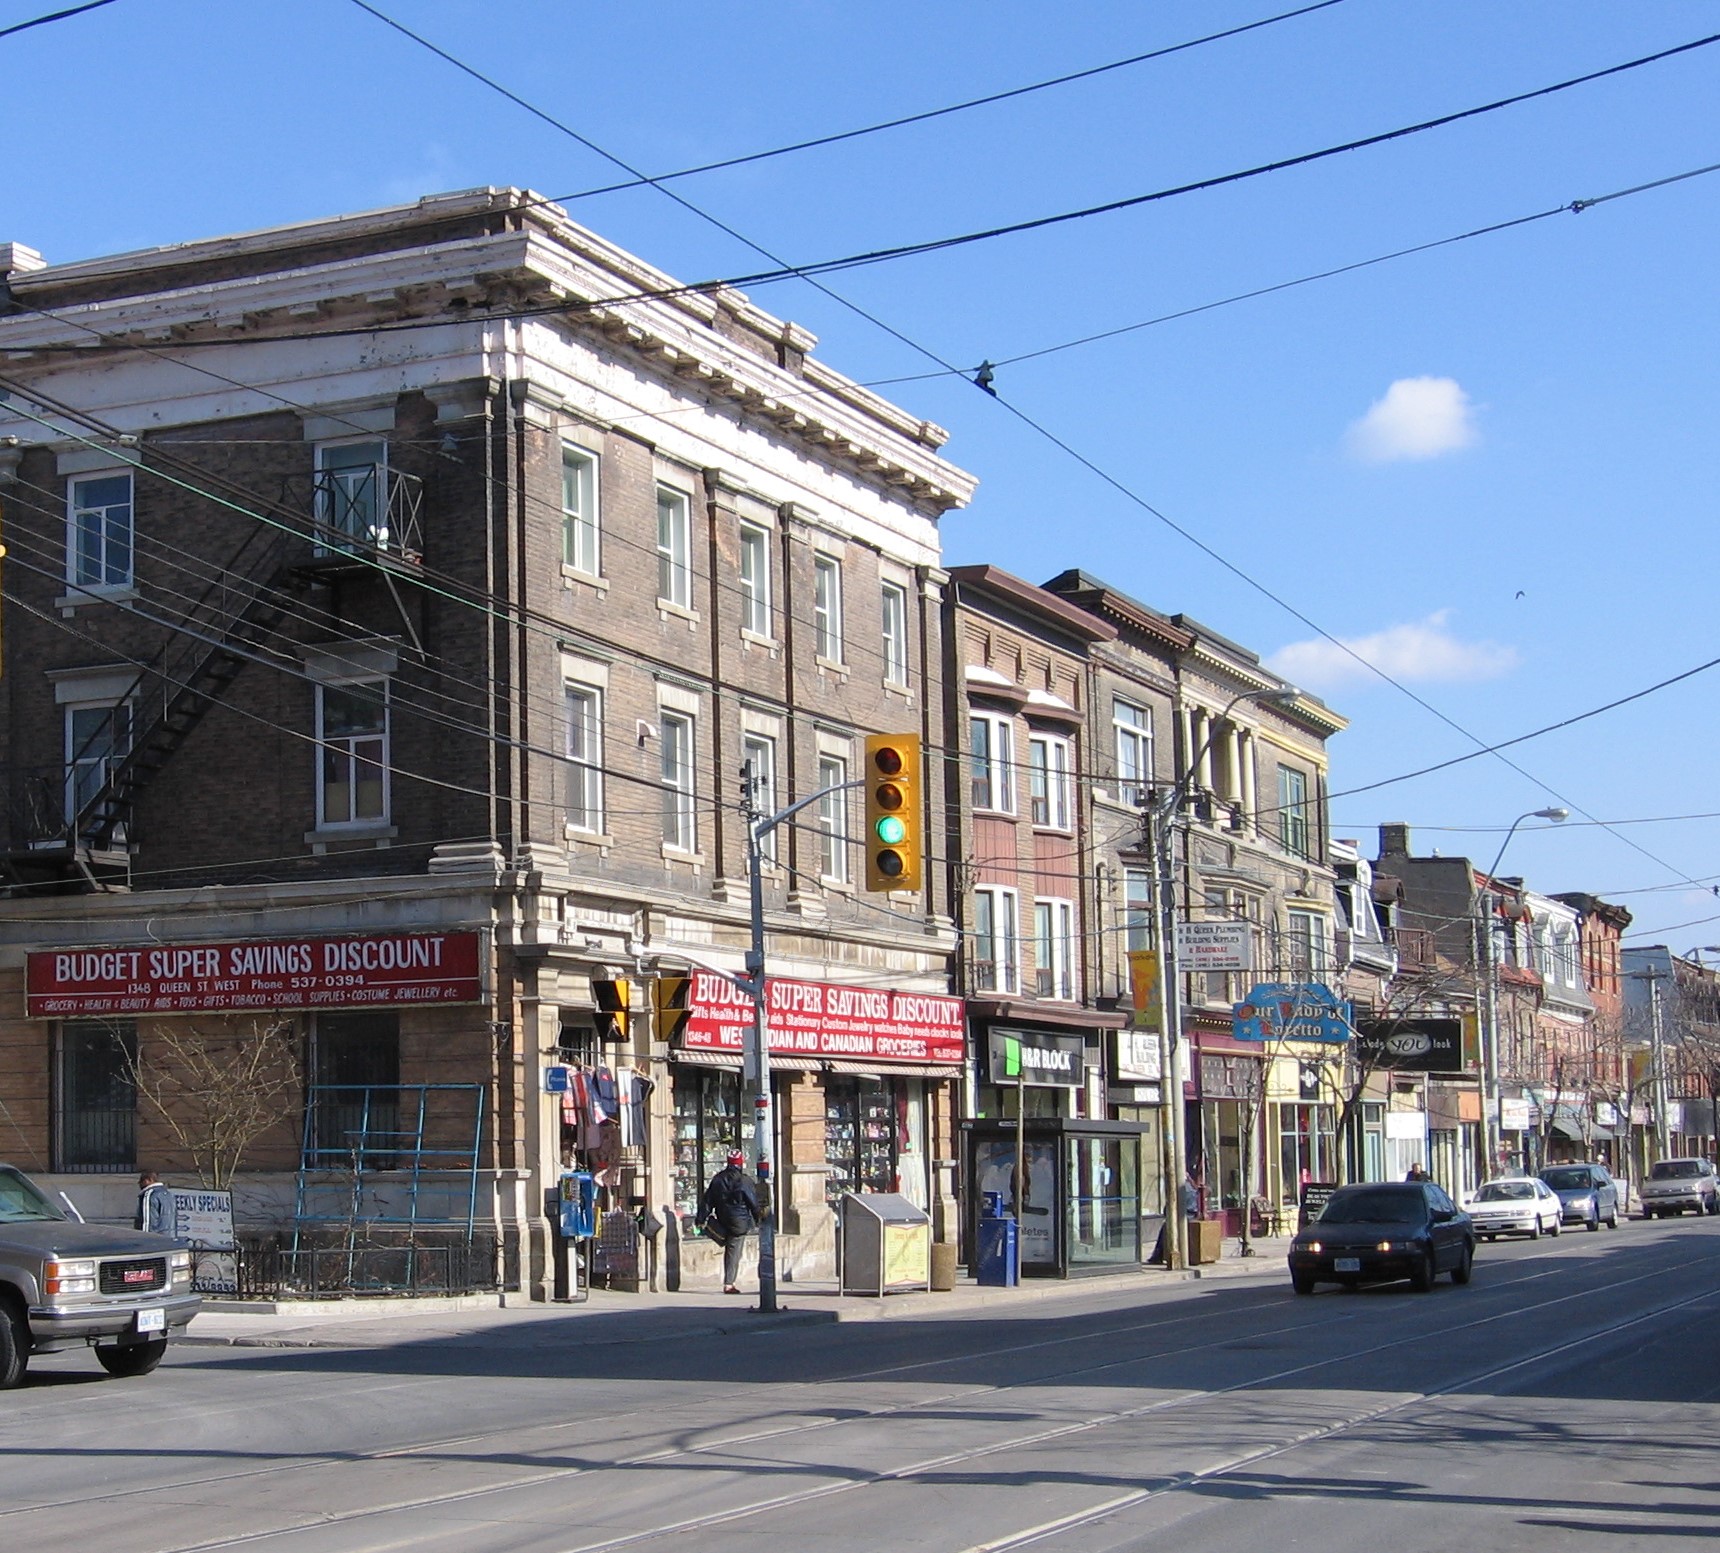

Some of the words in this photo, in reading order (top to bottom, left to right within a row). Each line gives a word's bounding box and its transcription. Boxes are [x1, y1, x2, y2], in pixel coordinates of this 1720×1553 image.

[56, 953, 141, 981] BUDGET
[150, 949, 220, 978] SUPER
[230, 944, 312, 974] SAVINGS
[324, 938, 444, 971] DISCOUNT
[127, 983, 150, 994] 1348
[159, 982, 191, 994] QUEEN
[197, 981, 208, 992] ST
[214, 979, 240, 991] WEST
[251, 978, 284, 990] Phone
[290, 974, 365, 989] 537-0394
[44, 1000, 77, 1011] GROCERY
[83, 998, 112, 1010] HEALTH
[120, 998, 151, 1010] BEAUTY
[153, 997, 172, 1009] AIDS
[179, 996, 197, 1008] TOYS
[203, 995, 225, 1007] GIFTS
[231, 994, 266, 1005] TOBACCO
[272, 991, 304, 1005] SCHOOL
[309, 990, 346, 1003] SUPPLIES
[351, 988, 391, 1001] COSTUME
[393, 986, 441, 1000] JEWELLERY
[696, 973, 755, 1007] BUDG
[772, 982, 822, 1013] SUPER
[827, 988, 889, 1020] SAVINGS
[1238, 1005, 1275, 1020] Our
[719, 1025, 743, 1045] WES
[794, 1031, 818, 1051] AND
[820, 1033, 874, 1053] CANADIAN
[876, 1036, 927, 1057] GROCERIES
[1041, 1049, 1071, 1071] BLOCK
[175, 1196, 197, 1211] EEKLY
[198, 1196, 231, 1213] SPECIALS
